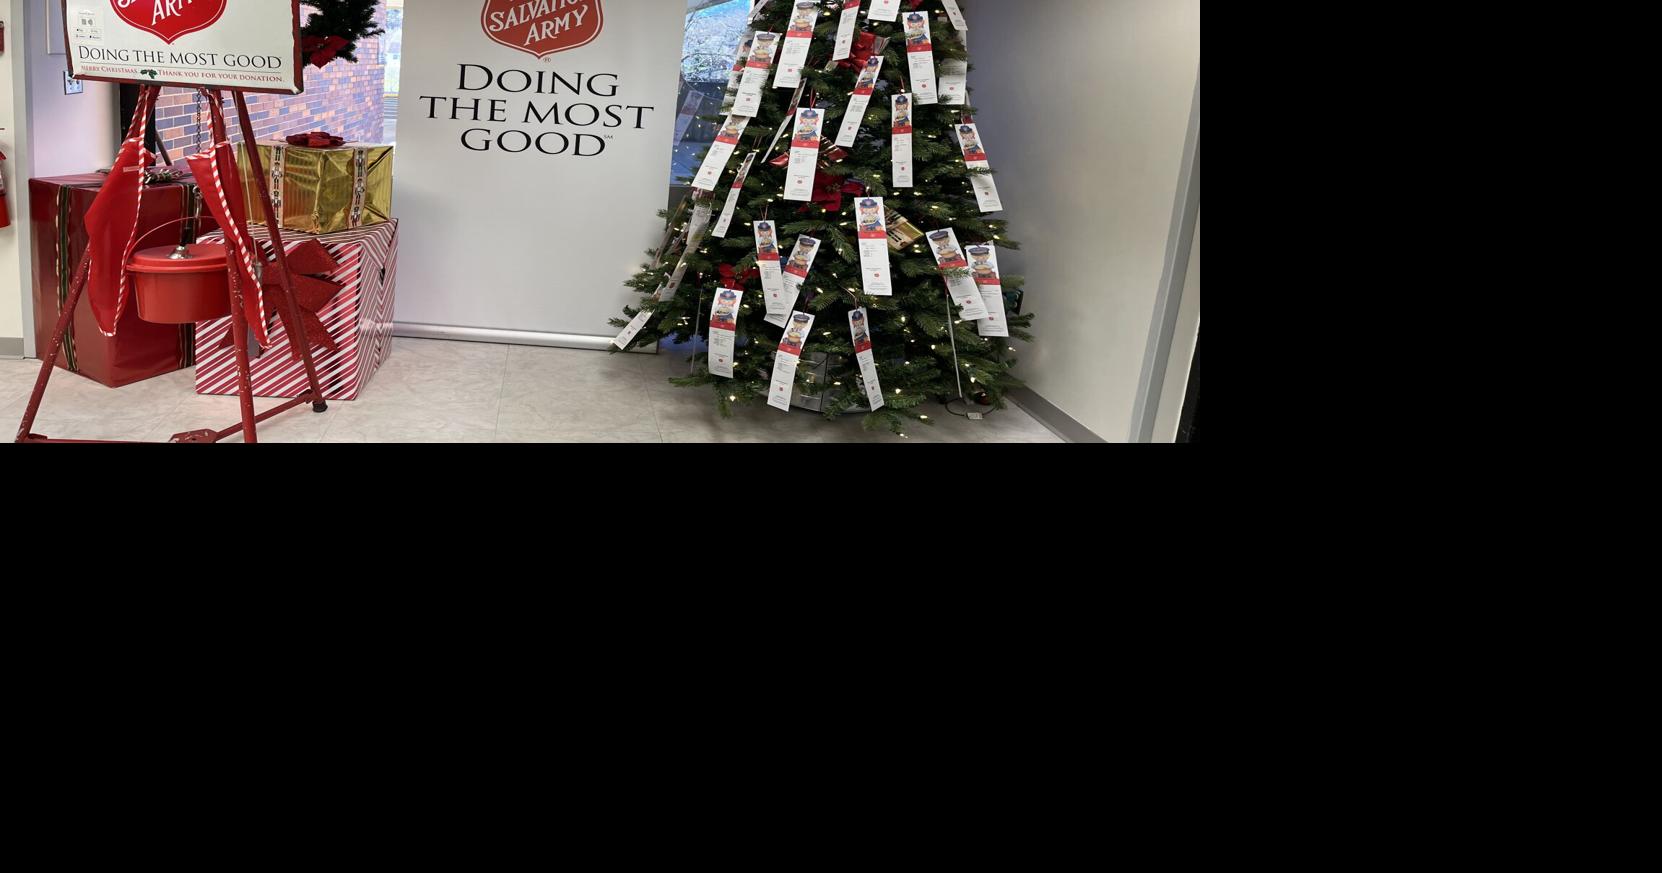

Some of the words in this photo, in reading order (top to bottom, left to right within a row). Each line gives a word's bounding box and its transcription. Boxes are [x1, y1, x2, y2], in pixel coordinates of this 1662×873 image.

[523, 4, 588, 46] ARMY
[78, 45, 129, 62] DOING
[132, 50, 165, 64] THE
[169, 52, 218, 66] MOST
[223, 53, 282, 69] GOOD
[158, 69, 182, 77] THANK
[456, 63, 619, 97] DOING
[419, 95, 507, 123] THE
[523, 100, 655, 129] MOST
[460, 128, 606, 157] GOOD
